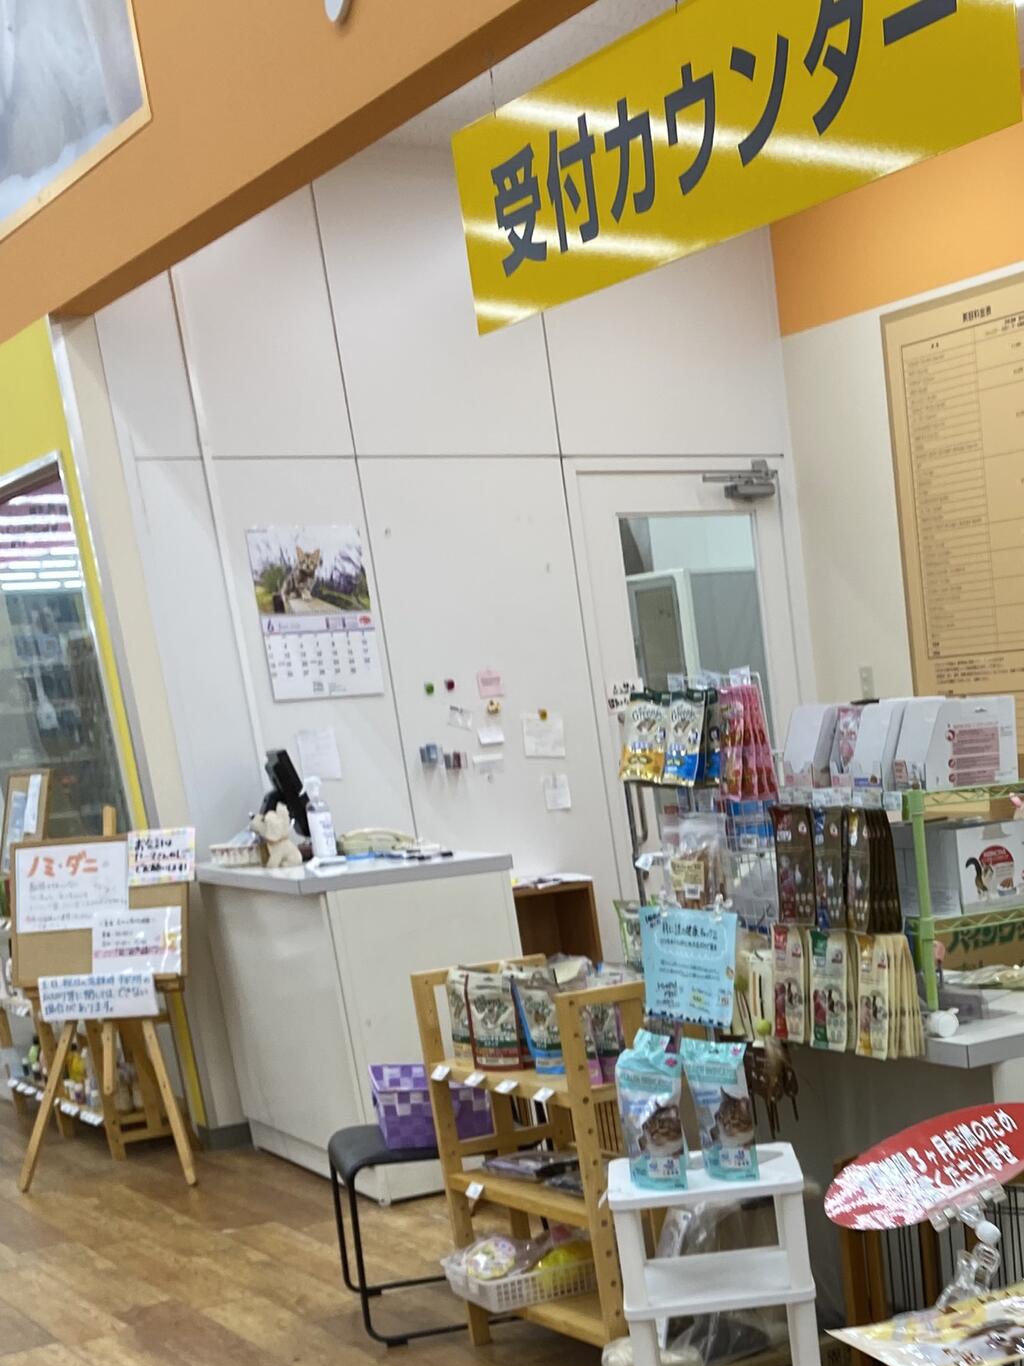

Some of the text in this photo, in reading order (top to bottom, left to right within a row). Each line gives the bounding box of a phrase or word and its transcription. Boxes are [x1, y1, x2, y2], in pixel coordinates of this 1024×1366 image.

[489, 0, 958, 277] 受付カウンター
